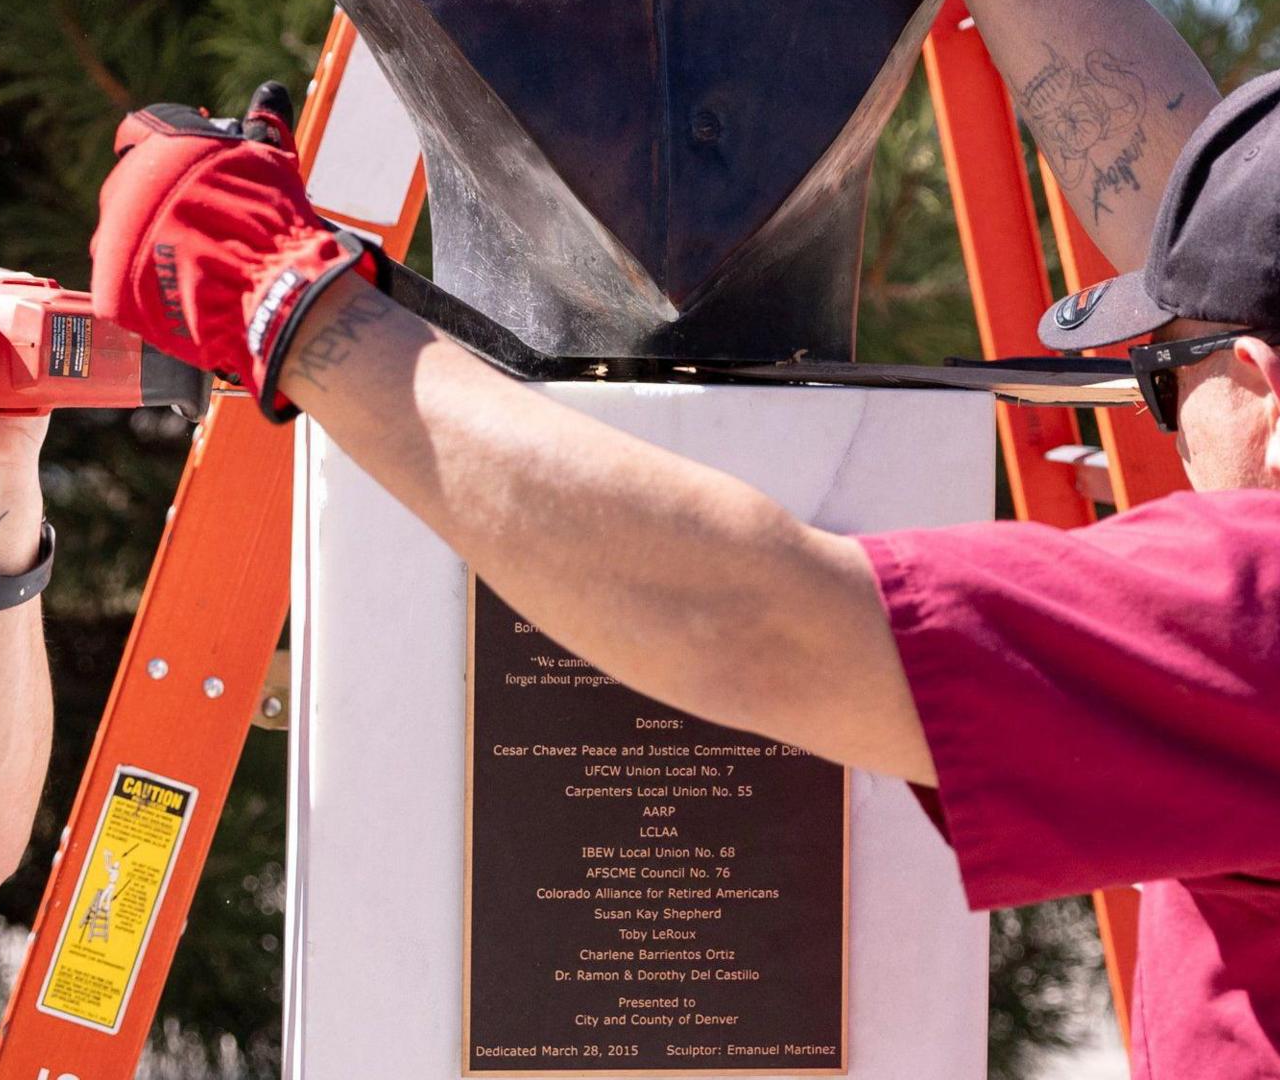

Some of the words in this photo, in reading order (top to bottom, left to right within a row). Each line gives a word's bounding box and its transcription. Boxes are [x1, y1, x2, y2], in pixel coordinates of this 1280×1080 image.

[558, 658, 594, 668] canno
[505, 672, 537, 688] forget
[539, 672, 572, 686] about
[635, 717, 684, 729] Donors:
[493, 744, 530, 756] Cesar
[532, 744, 578, 757] Chavez
[581, 744, 617, 757] Peace
[621, 745, 644, 757] and
[648, 744, 690, 756] Justice
[693, 744, 761, 757] Committee
[764, 743, 778, 757] of
[584, 764, 622, 777] UFCW
[625, 765, 661, 777] Union
[665, 765, 697, 777] Local
[700, 765, 721, 777] No.
[726, 765, 735, 776] 7
[121, 776, 184, 811] CAUTION
[564, 785, 633, 799] Carpenters
[636, 785, 668, 797] Local
[672, 785, 708, 797] Union
[712, 785, 733, 797] No.
[737, 785, 753, 797] 55
[642, 805, 676, 817] AARP
[639, 826, 679, 838] LCLAA
[581, 846, 615, 858] IBEW
[619, 847, 651, 858] Local
[655, 847, 690, 858] Union
[694, 846, 715, 858] No.
[719, 846, 736, 858] 68
[585, 867, 637, 879] AFSCME
[640, 867, 685, 879] Council
[689, 867, 710, 879] No.
[715, 866, 731, 879] 76
[536, 887, 591, 900] Colorado
[594, 887, 643, 899] Alliance
[646, 887, 664, 899] for
[667, 887, 712, 899] Retired
[715, 887, 780, 899] Americans
[594, 908, 632, 920] Susan
[636, 908, 659, 921] Kay
[663, 907, 722, 921] Shepherd
[618, 928, 648, 942] Toby
[652, 928, 696, 940] LeRoux
[579, 949, 635, 961] Charlene
[638, 949, 702, 960] Barrientos
[705, 948, 736, 960] Ortiz
[554, 969, 572, 982] Dr.
[576, 969, 620, 981] Ramon
[623, 969, 633, 981] &
[637, 969, 686, 983] Dorothy
[690, 969, 711, 981] Del
[714, 969, 760, 981] Castillo
[618, 996, 679, 1009] Presented
[683, 997, 696, 1008] to
[574, 1014, 599, 1028] City
[603, 1014, 627, 1026] and
[630, 1013, 674, 1027] County
[678, 1013, 691, 1025] of
[695, 1013, 739, 1025] Denver
[475, 1045, 537, 1057] Dedicated
[541, 1045, 579, 1057] March
[583, 1045, 603, 1058] 28,
[607, 1044, 639, 1056] 2015
[666, 1044, 722, 1058] Sculptor:
[727, 1044, 780, 1056] Emanuel
[784, 1044, 836, 1055] Martinez
